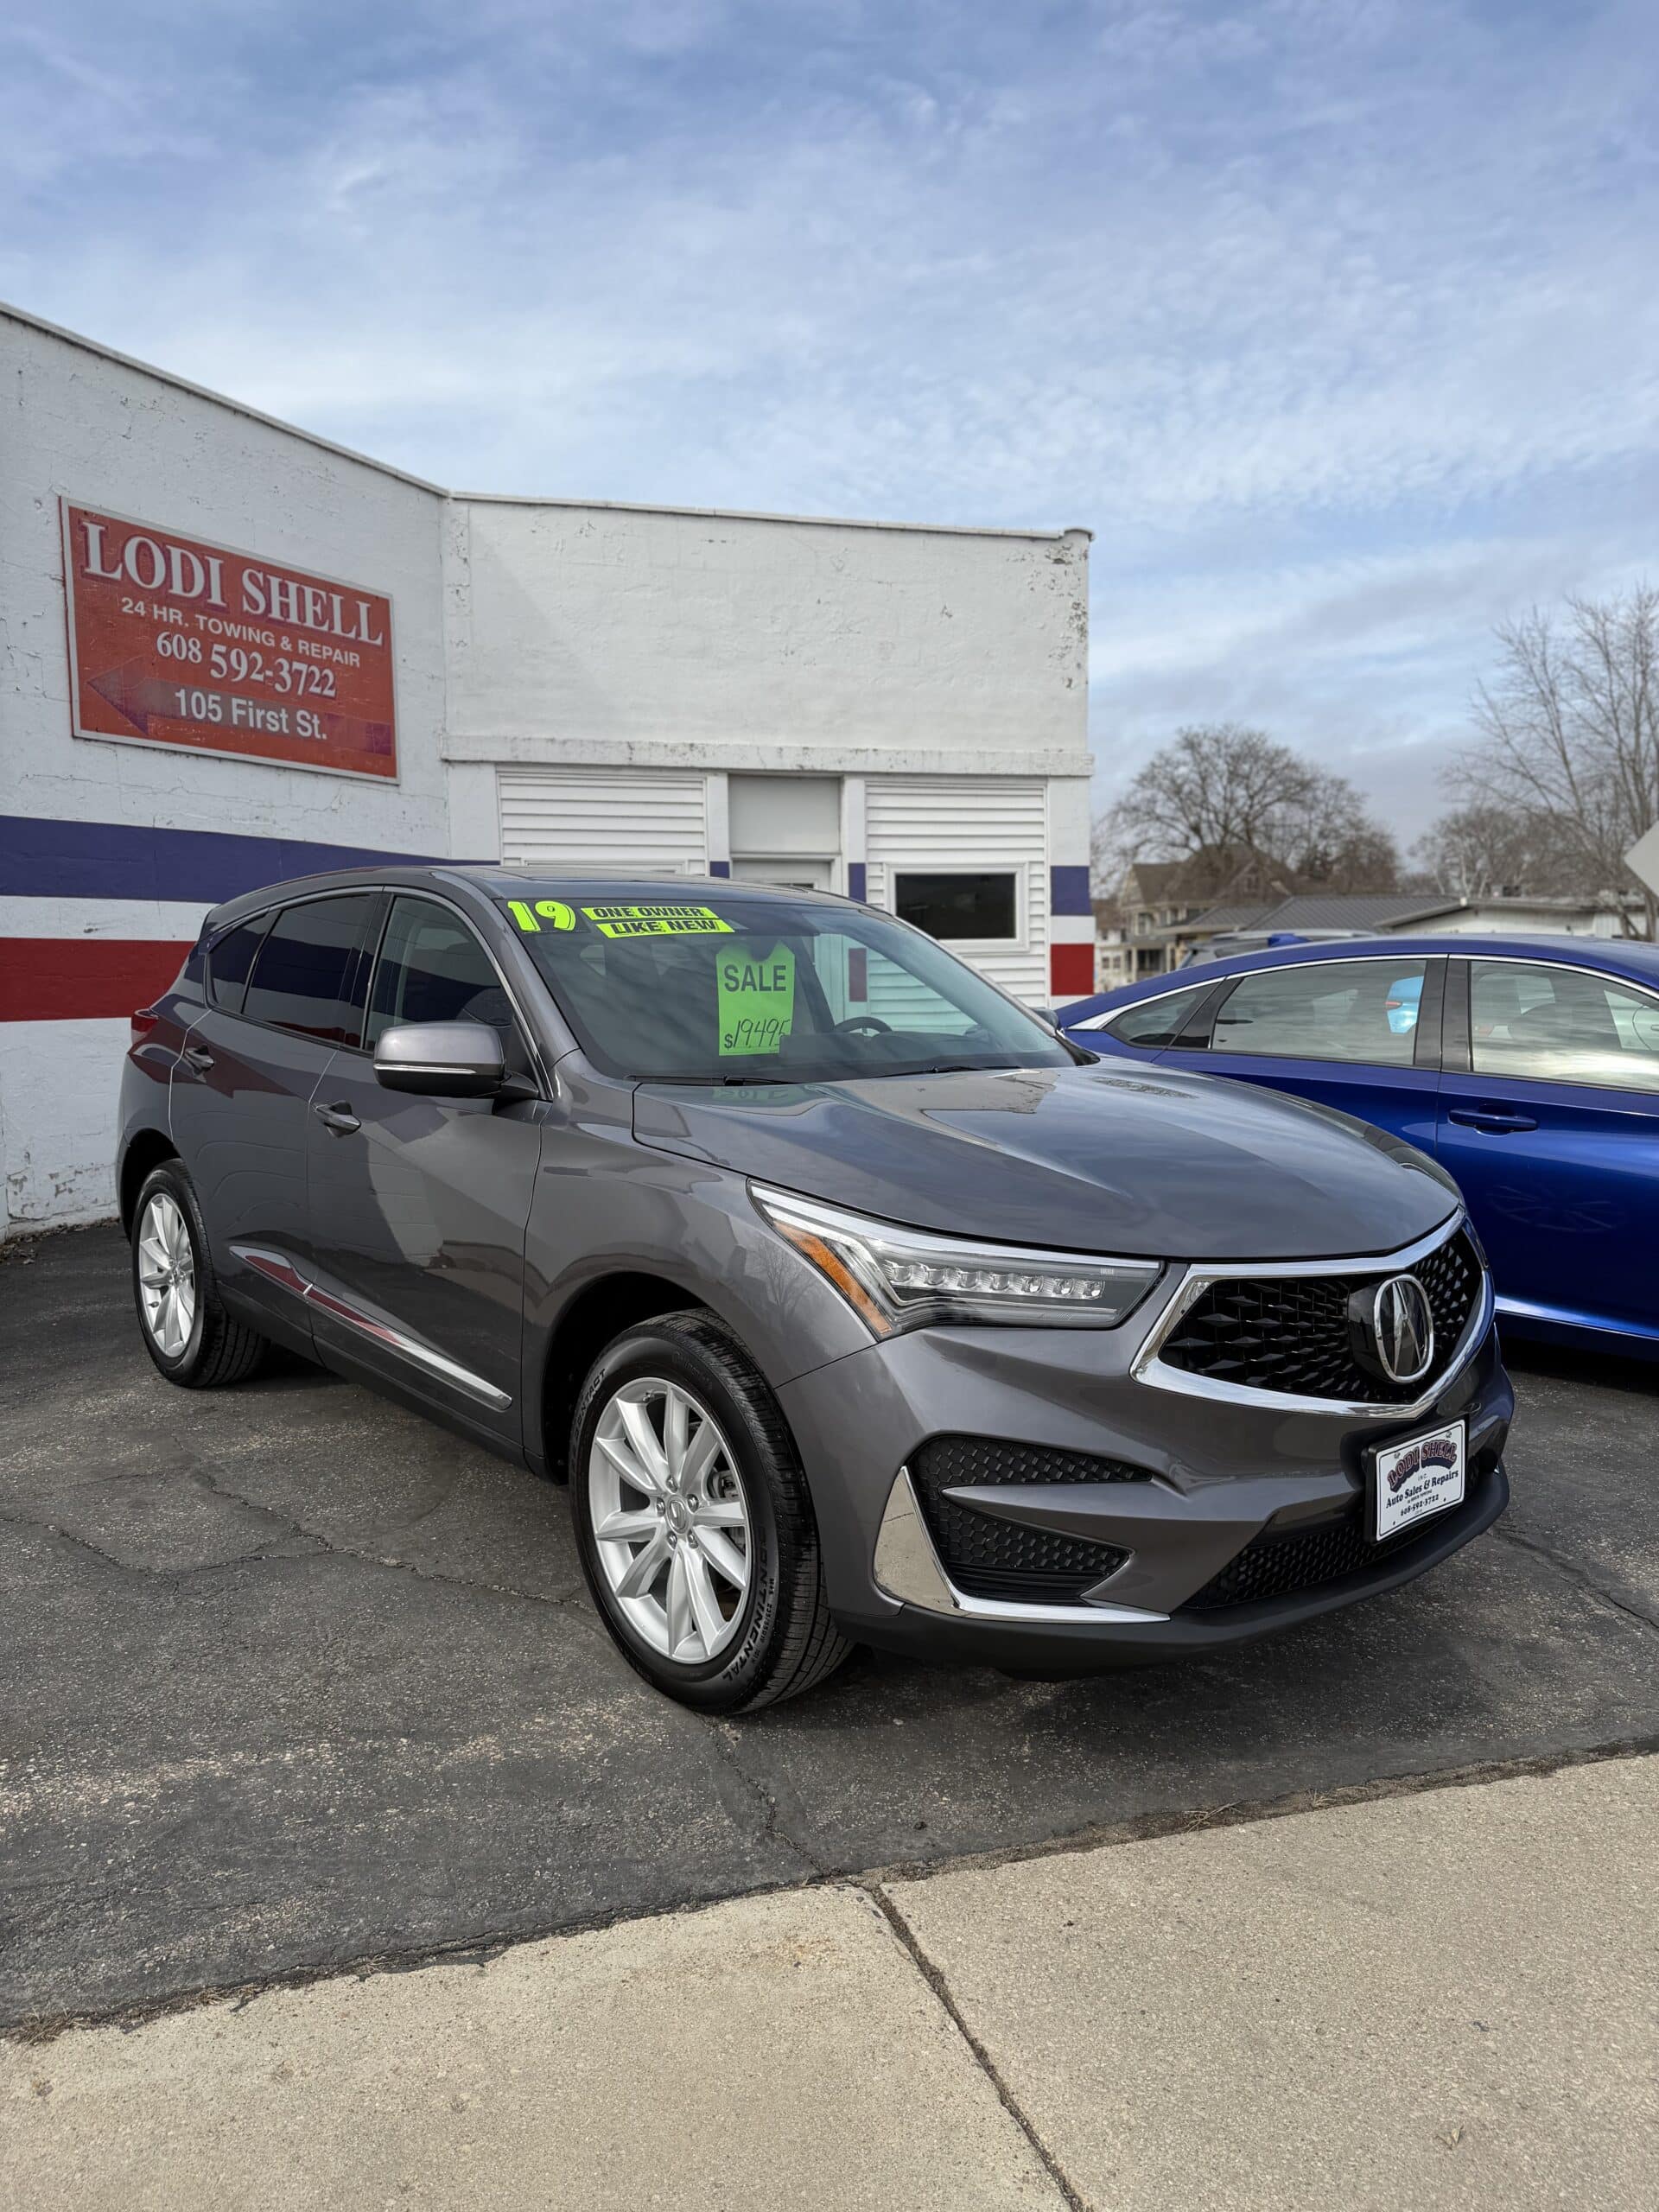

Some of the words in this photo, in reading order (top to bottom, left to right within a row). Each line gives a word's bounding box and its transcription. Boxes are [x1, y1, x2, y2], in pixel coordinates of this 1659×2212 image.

[82, 520, 226, 607] LODI
[241, 567, 384, 646] SHELL
[121, 597, 146, 616] 24
[153, 604, 189, 627] HR.
[195, 613, 276, 647] TOWING
[280, 635, 293, 652] &
[298, 641, 361, 667] REPAIR
[156, 631, 202, 664] 608
[210, 644, 337, 698] 592-3722
[175, 689, 223, 722] 105
[232, 698, 289, 734] First
[296, 709, 328, 740] St.
[507, 900, 576, 931] 19
[593, 907, 634, 918] ONE
[638, 907, 705, 917] OWNER
[610, 921, 663, 935] LIKE
[664, 919, 717, 931] NEW
[724, 964, 787, 993] SALE
[1386, 1493, 1404, 1509] Auto
[1405, 1484, 1422, 1498] Sales
[1424, 1479, 1430, 1490] &
[1432, 1471, 1459, 1485] Repairs
[1387, 1446, 1420, 1491] LODI
[1421, 1440, 1457, 1464] SHELL
[722, 1526, 768, 1682] CONTINENTAL
